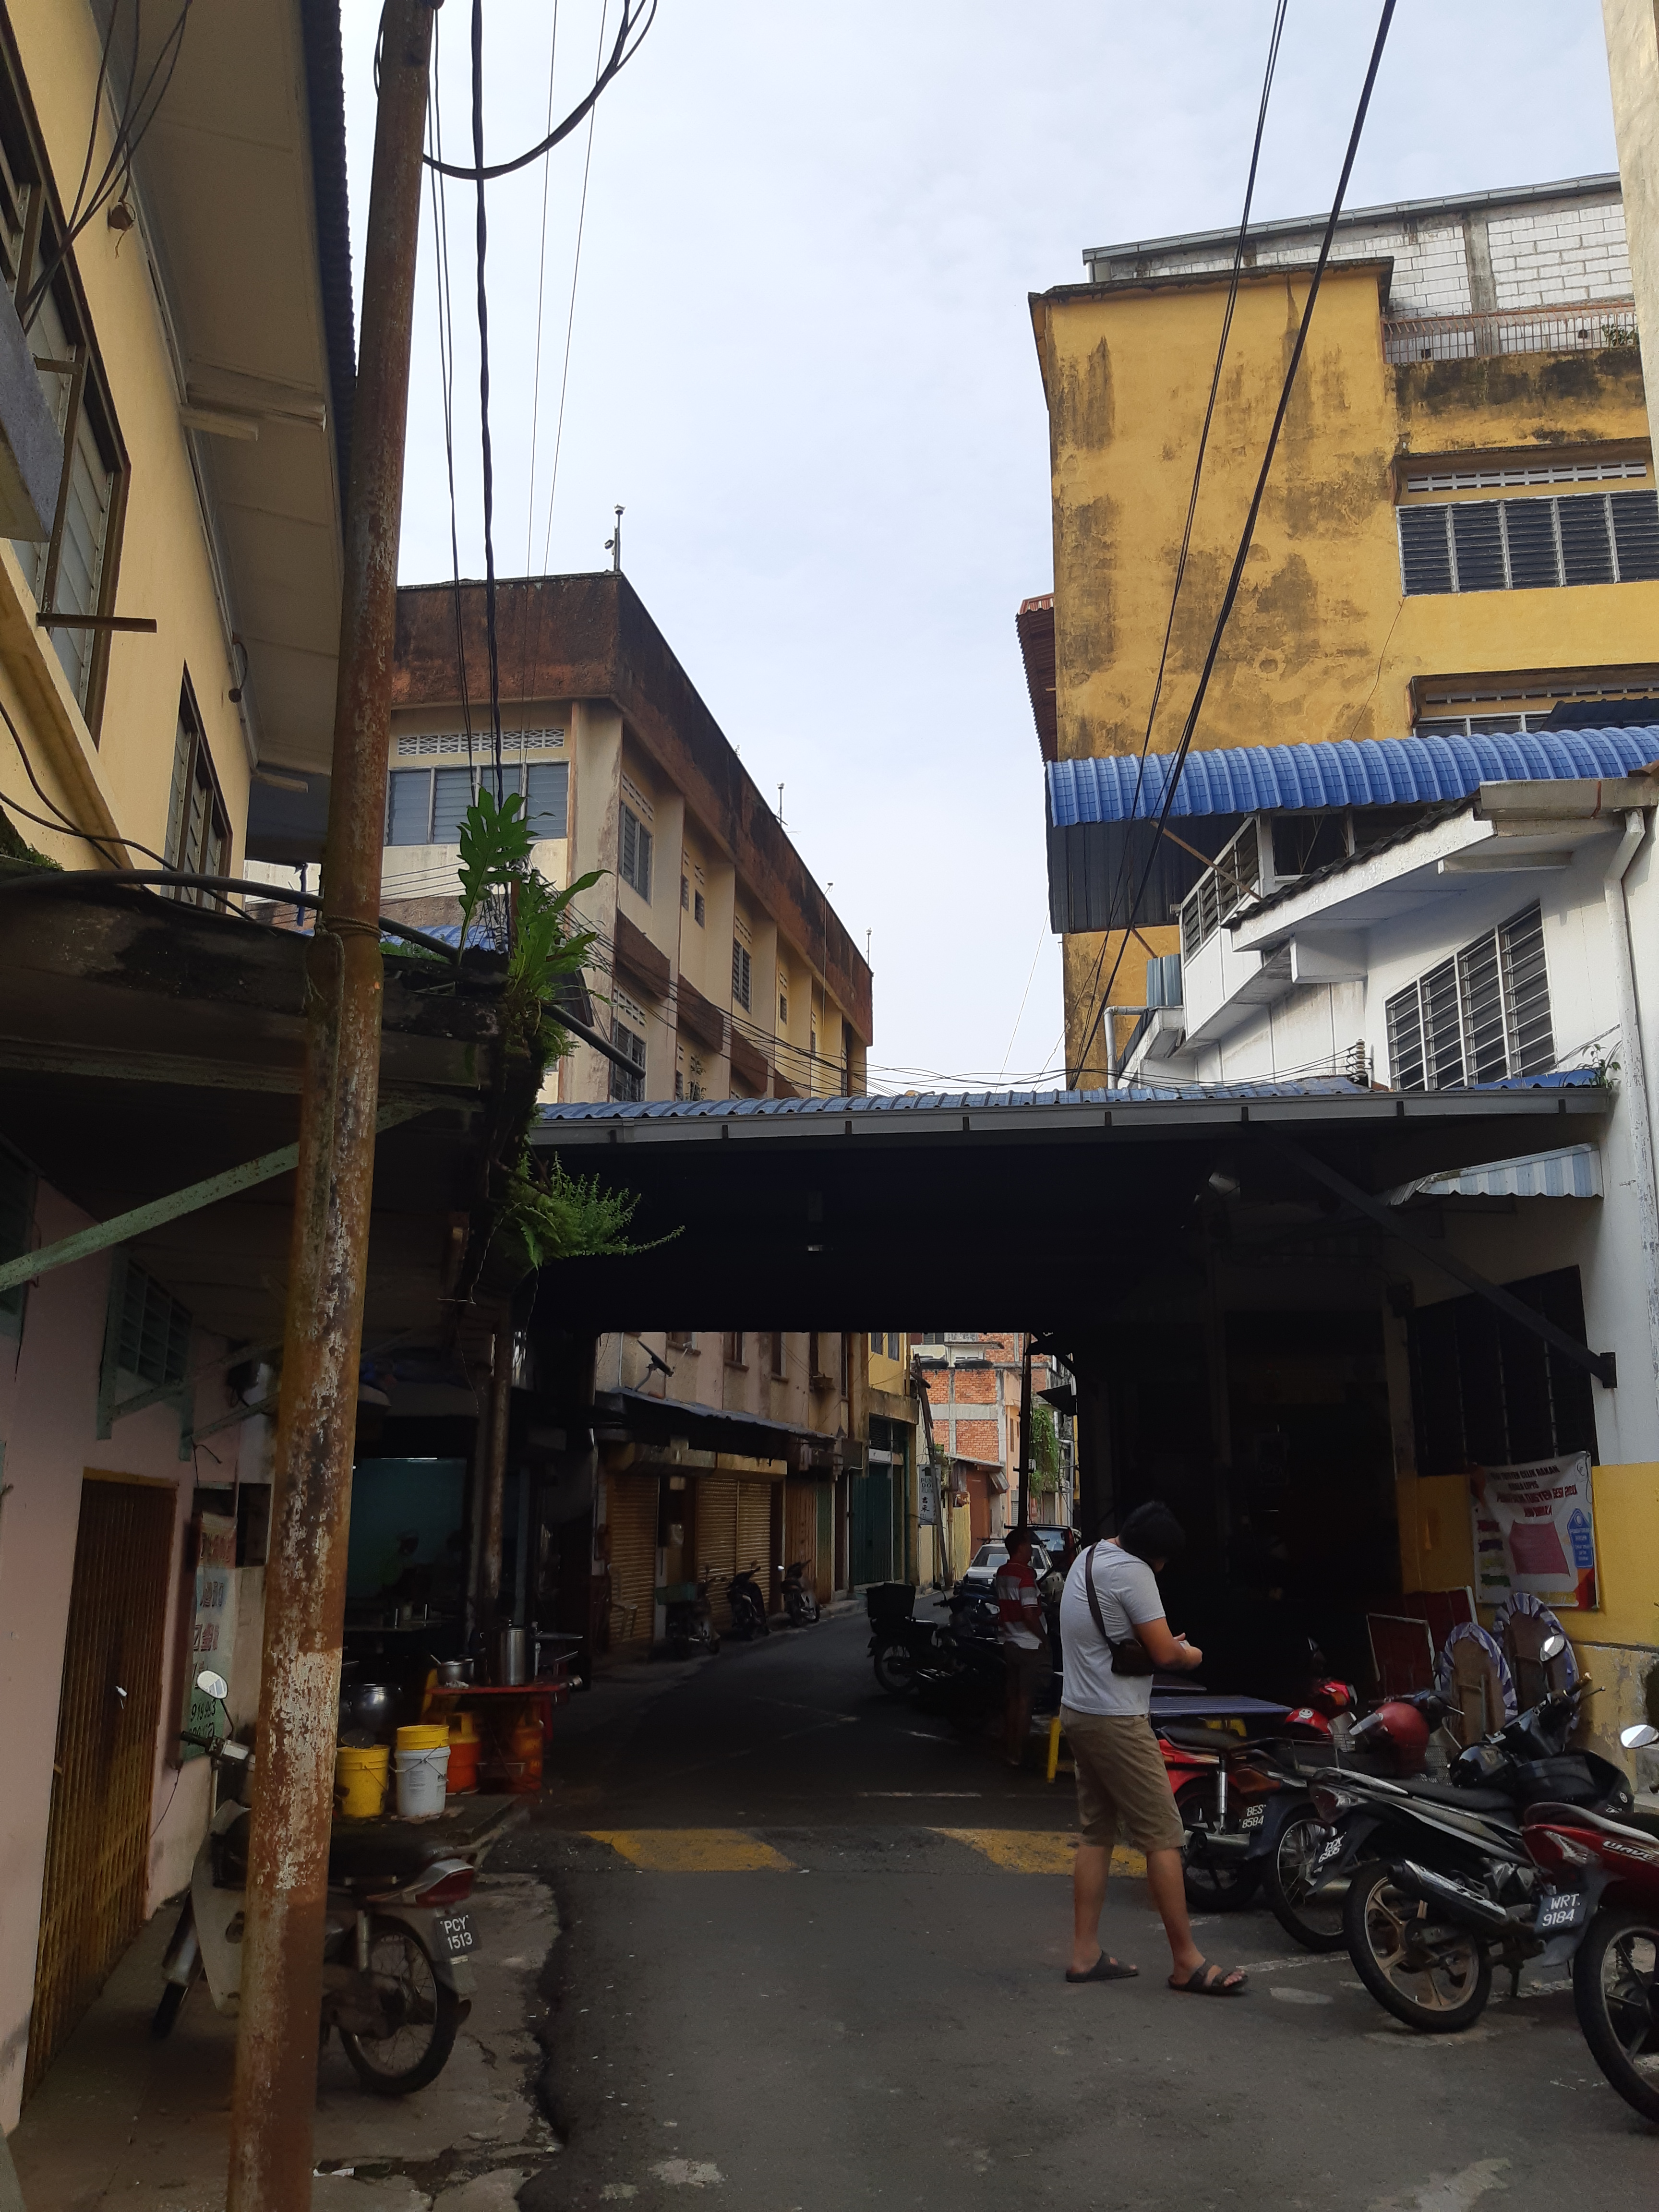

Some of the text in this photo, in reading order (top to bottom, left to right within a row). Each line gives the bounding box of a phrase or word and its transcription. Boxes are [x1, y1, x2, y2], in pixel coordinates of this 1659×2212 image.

[1246, 1803, 1264, 1817] BES
[1242, 1815, 1264, 1828] 8584
[1602, 1840, 1658, 1862] WAVE
[1551, 1892, 1580, 1910] WRT
[444, 1915, 466, 1934] PCY
[1542, 1908, 1575, 1927] 9184
[447, 1932, 473, 1950] 1513
